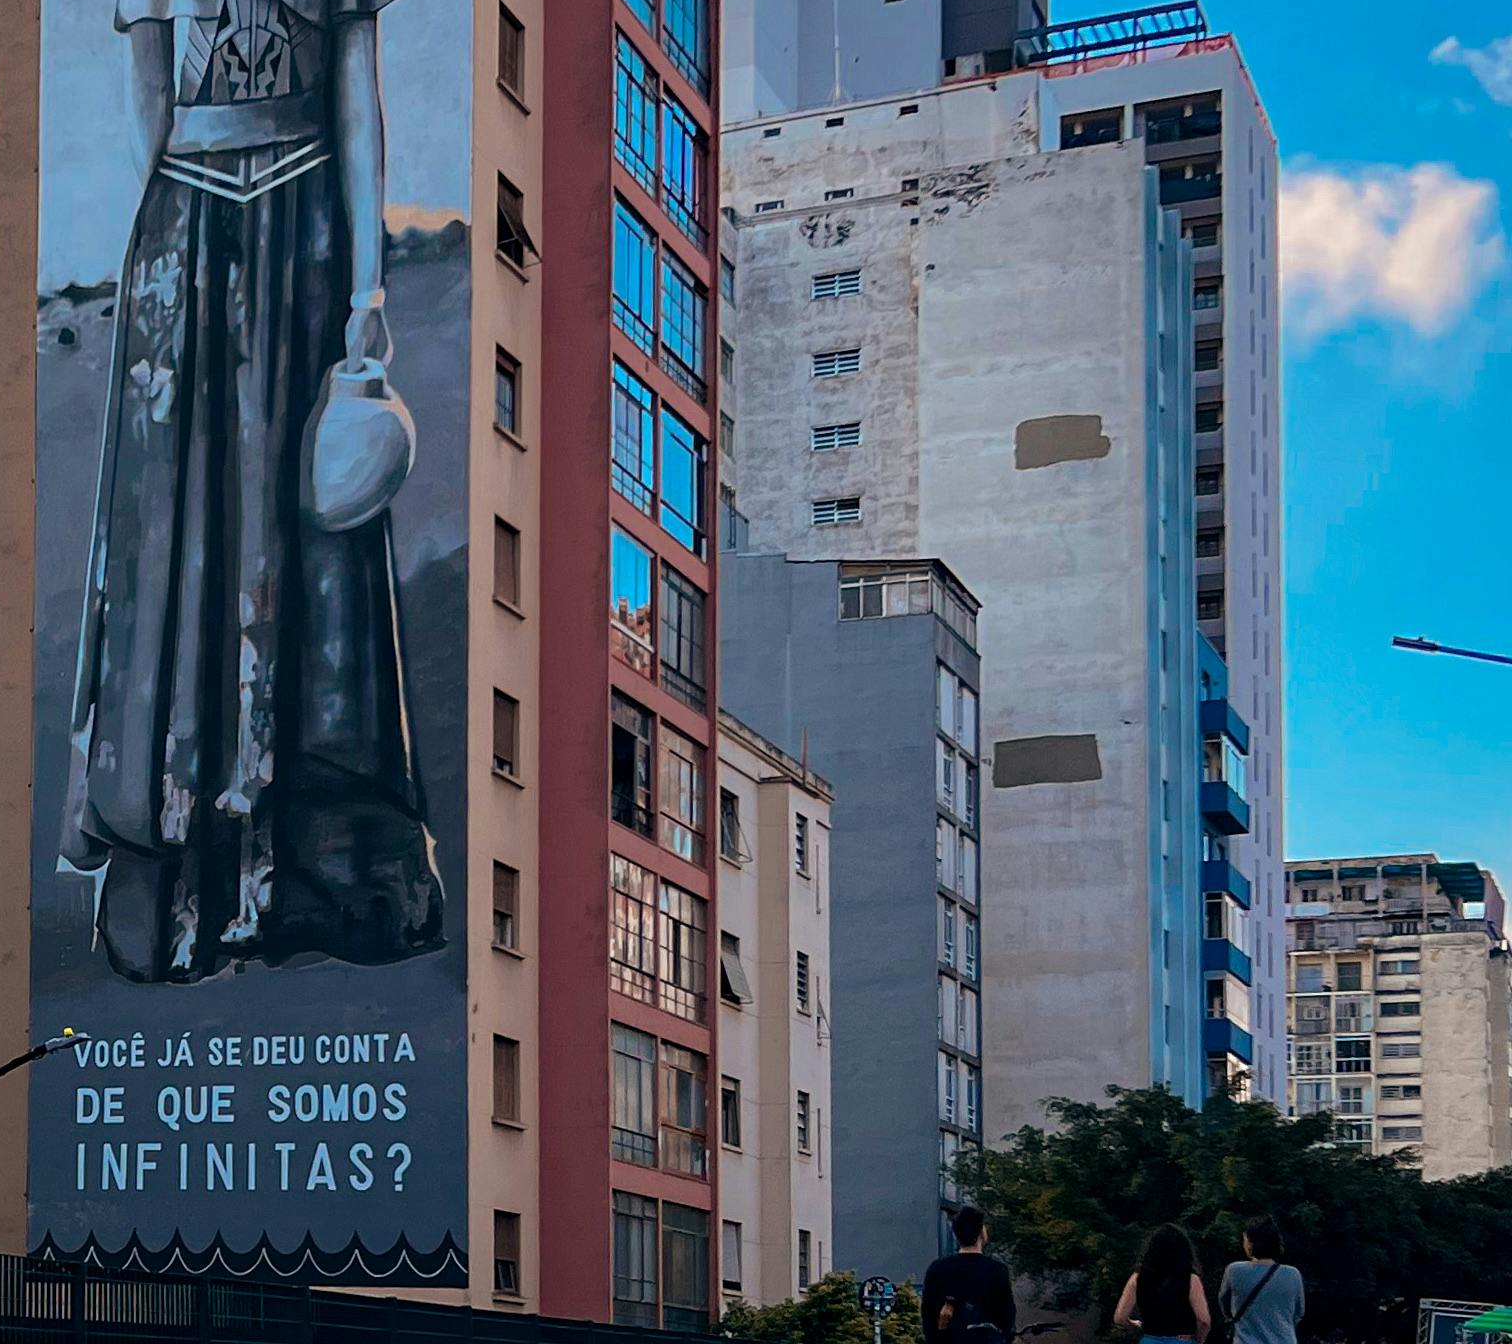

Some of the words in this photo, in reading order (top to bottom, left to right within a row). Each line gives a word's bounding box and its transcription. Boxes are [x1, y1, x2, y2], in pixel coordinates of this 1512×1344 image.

[74, 1032, 145, 1067] VOCÊ
[157, 1032, 193, 1067] JÁ
[208, 1037, 243, 1066] SE
[253, 1036, 305, 1065] DEU
[315, 1033, 416, 1063] CONTA
[76, 1087, 125, 1123] DE
[157, 1086, 235, 1130] QUE
[267, 1083, 407, 1122] SOMOS
[77, 1142, 412, 1191] INFINITAS?
